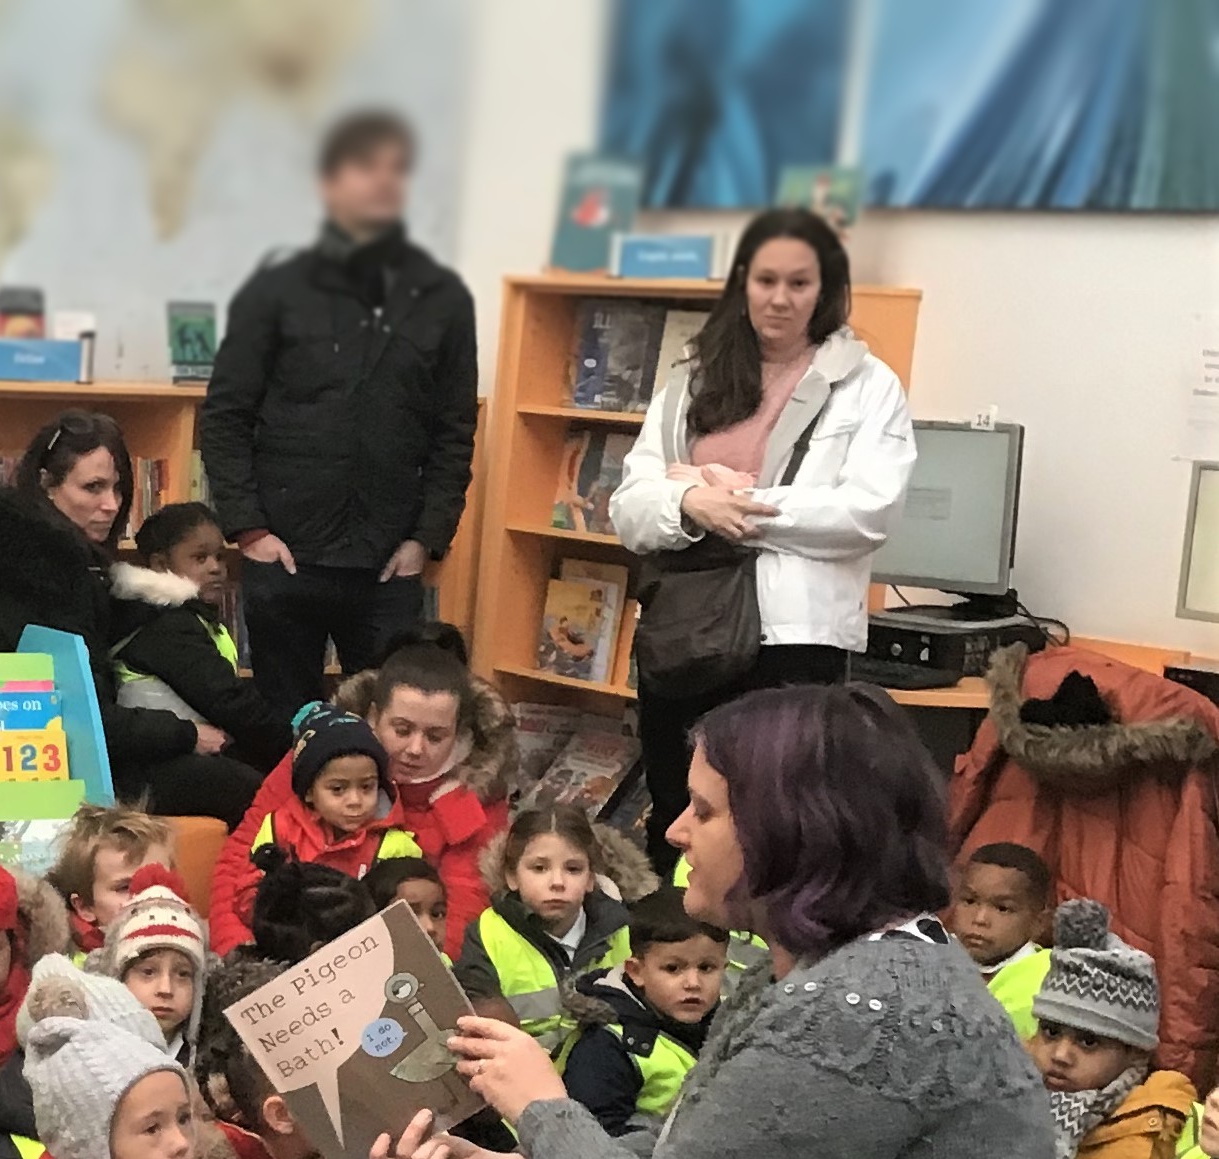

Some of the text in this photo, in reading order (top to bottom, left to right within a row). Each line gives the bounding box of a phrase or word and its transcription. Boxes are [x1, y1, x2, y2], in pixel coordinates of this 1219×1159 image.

[976, 413, 990, 427] 14
[22, 699, 43, 711] on
[240, 935, 380, 1026] The Pigeon
[258, 988, 356, 1053] Needs a
[366, 1023, 391, 1042] I do
[276, 1027, 345, 1078] Bath!
